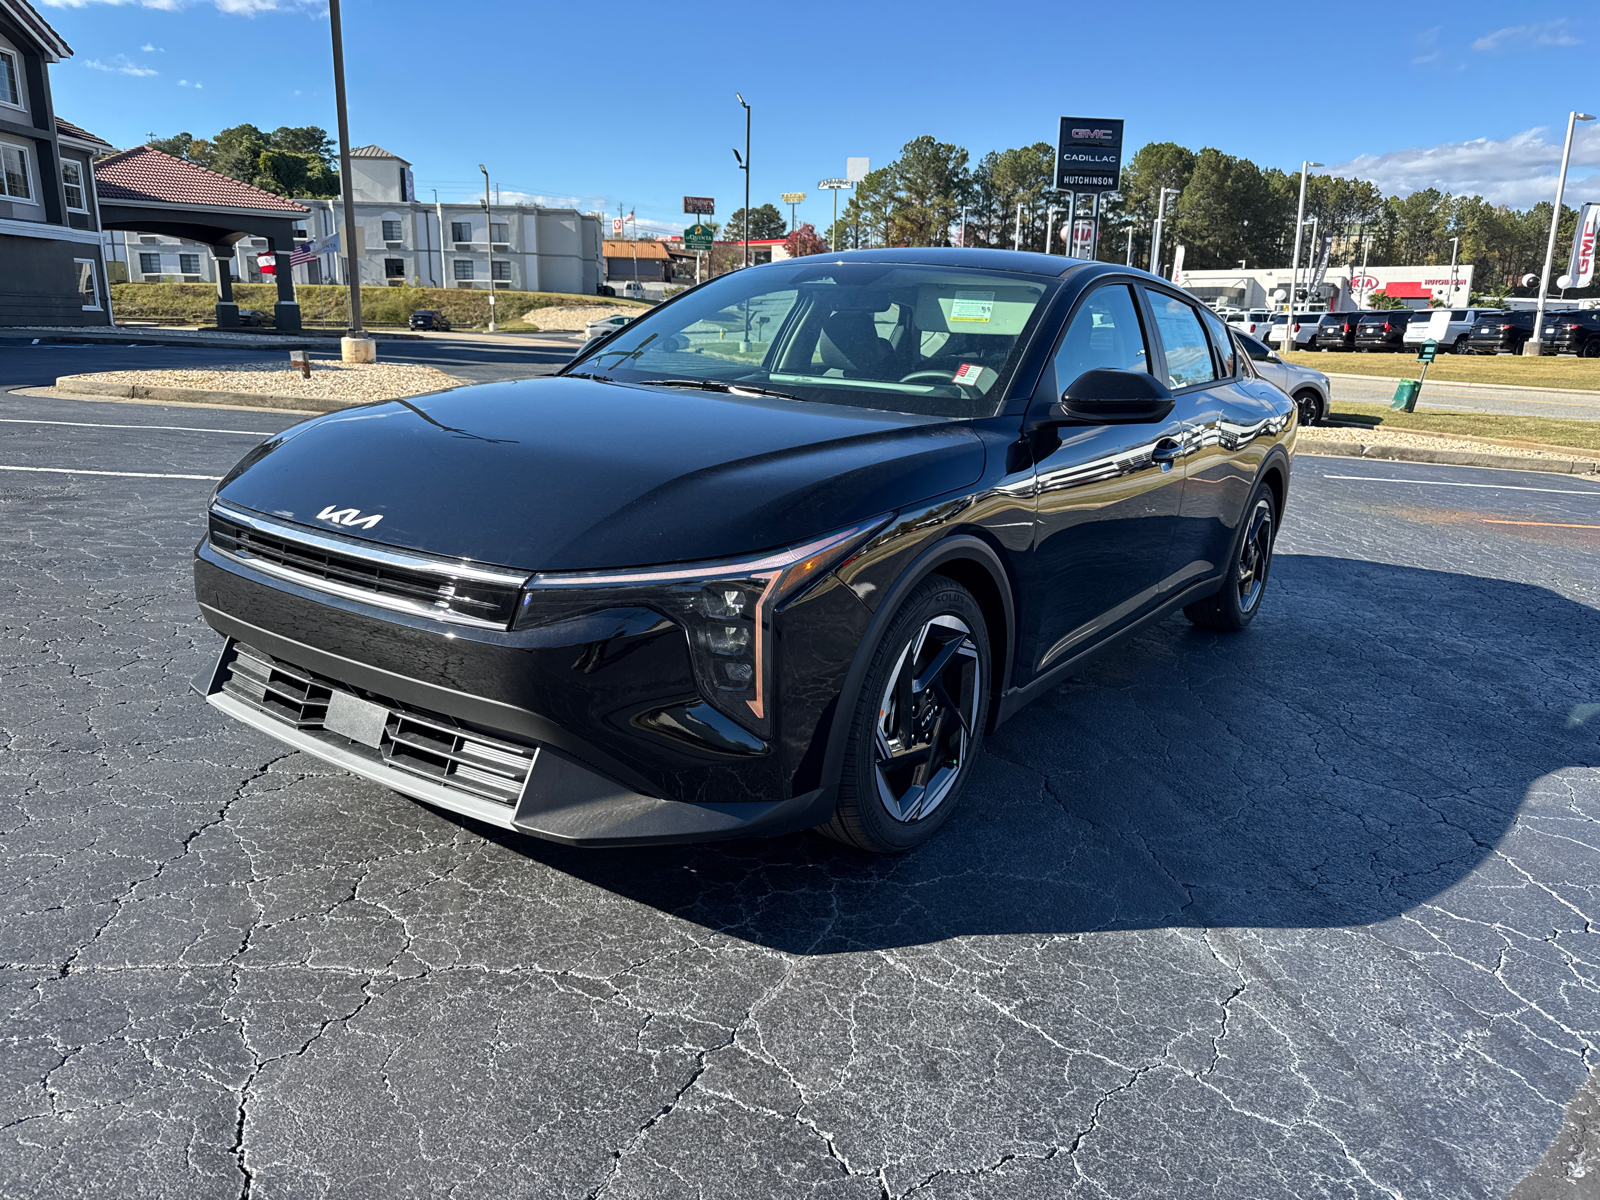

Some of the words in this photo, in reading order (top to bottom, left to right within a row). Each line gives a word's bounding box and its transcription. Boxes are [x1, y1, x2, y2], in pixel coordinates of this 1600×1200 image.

[1071, 128, 1113, 140] GMC
[1063, 153, 1117, 163] CADILLAC
[1063, 175, 1114, 186] HUTCHINSON
[1576, 222, 1596, 274] GMC
[1311, 245, 1331, 293] CADILLAC
[1351, 278, 1374, 288] KA
[316, 504, 384, 530] KIA
[935, 593, 965, 605] SOLUS
